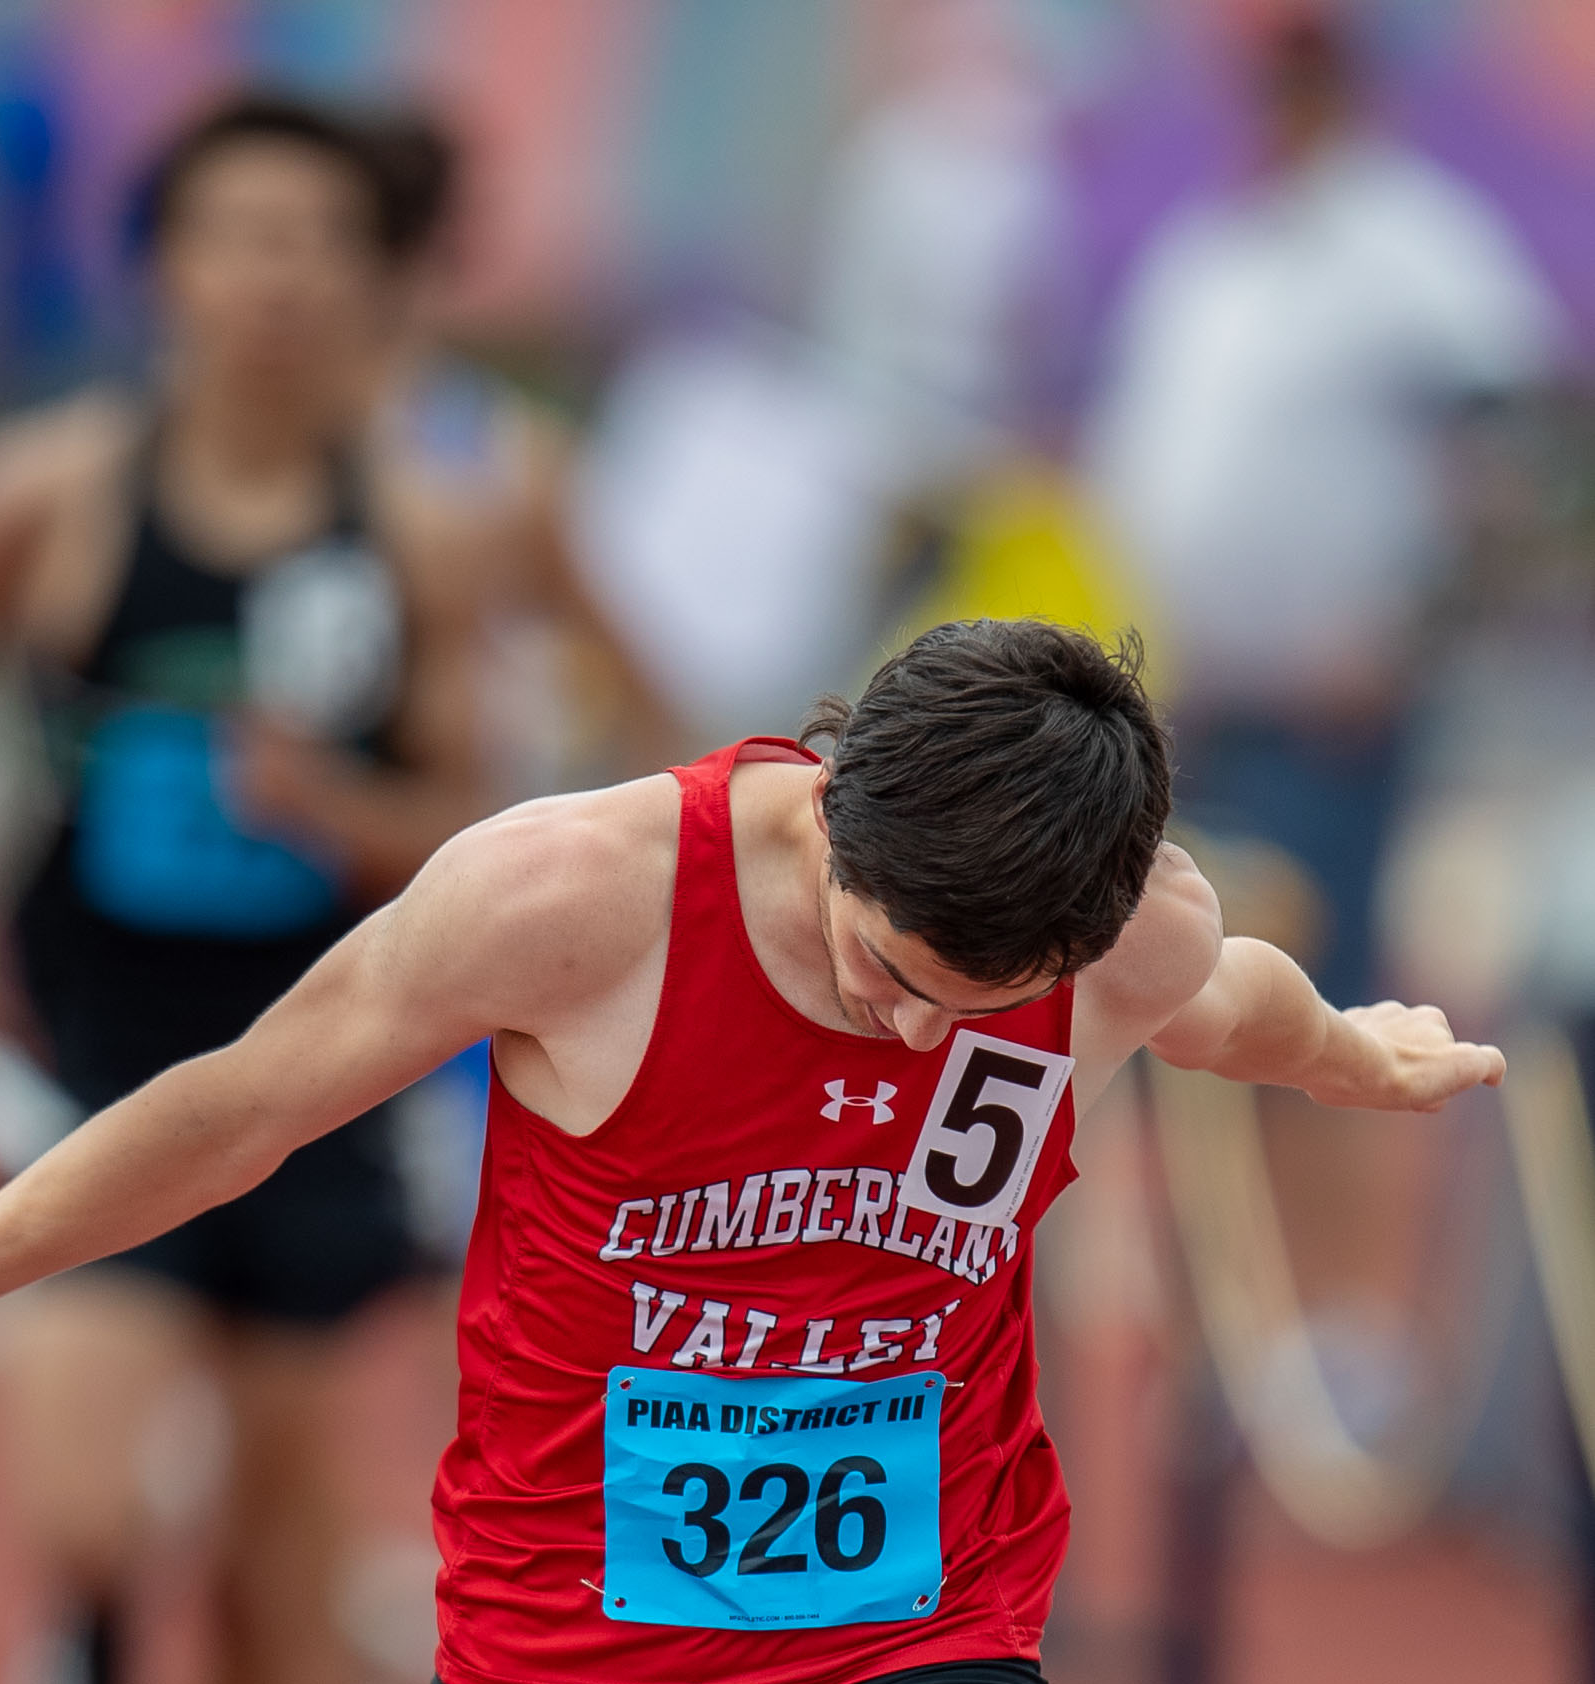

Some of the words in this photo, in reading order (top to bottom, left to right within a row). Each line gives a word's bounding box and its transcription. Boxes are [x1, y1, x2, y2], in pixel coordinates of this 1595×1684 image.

[925, 1046, 1047, 1208] 5
[627, 1398, 710, 1432] PIAA
[720, 1399, 882, 1436] DISTRICT
[887, 1394, 926, 1422] III
[661, 1455, 887, 1579] 326
